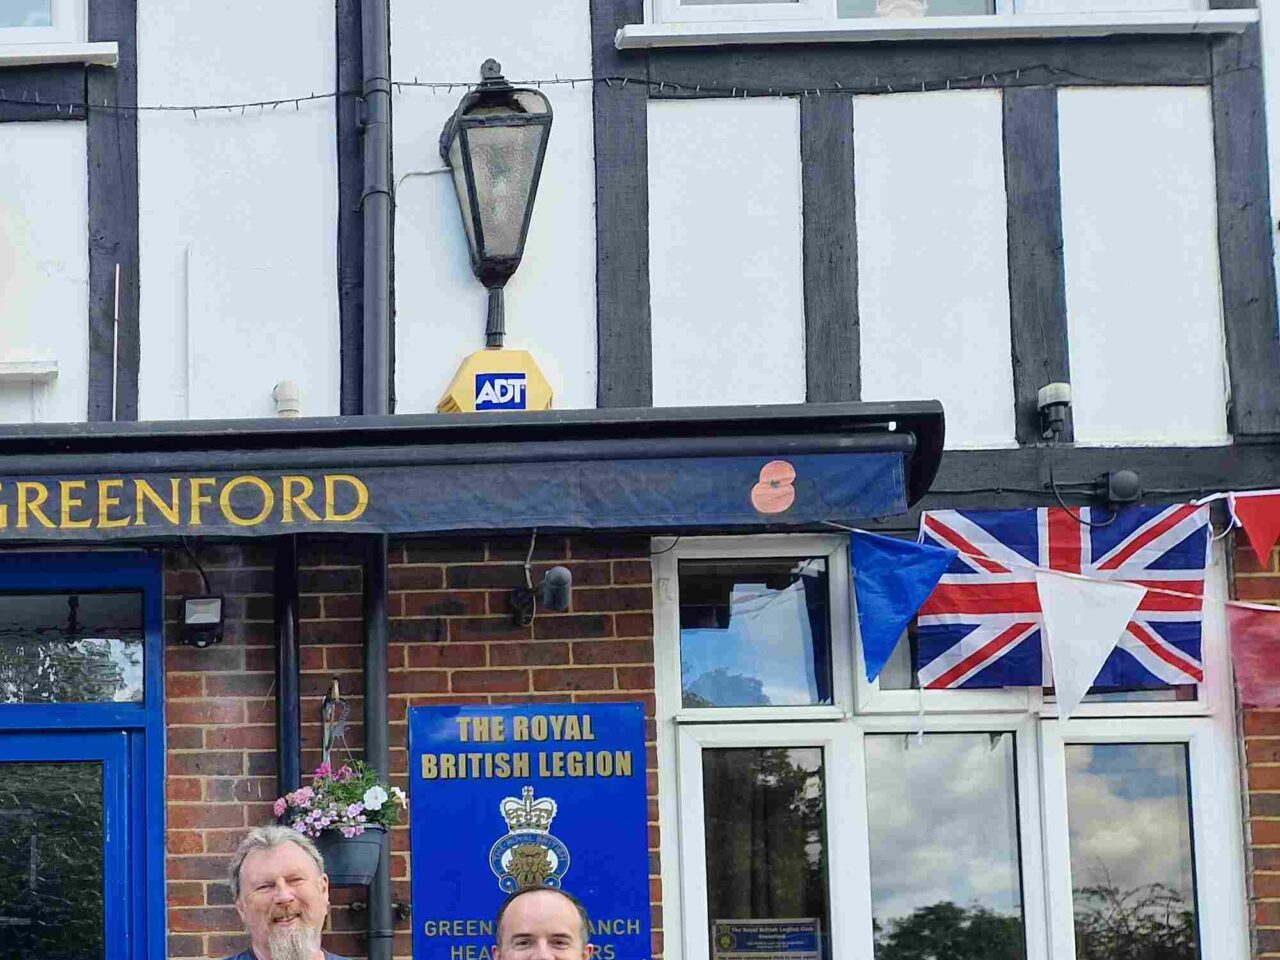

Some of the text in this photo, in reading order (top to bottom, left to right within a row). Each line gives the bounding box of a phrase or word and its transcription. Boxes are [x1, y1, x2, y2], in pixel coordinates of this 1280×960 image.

[476, 378, 526, 404] ADT
[456, 714, 595, 742] THE ROYAL
[421, 750, 633, 779] BRITISH LEGION
